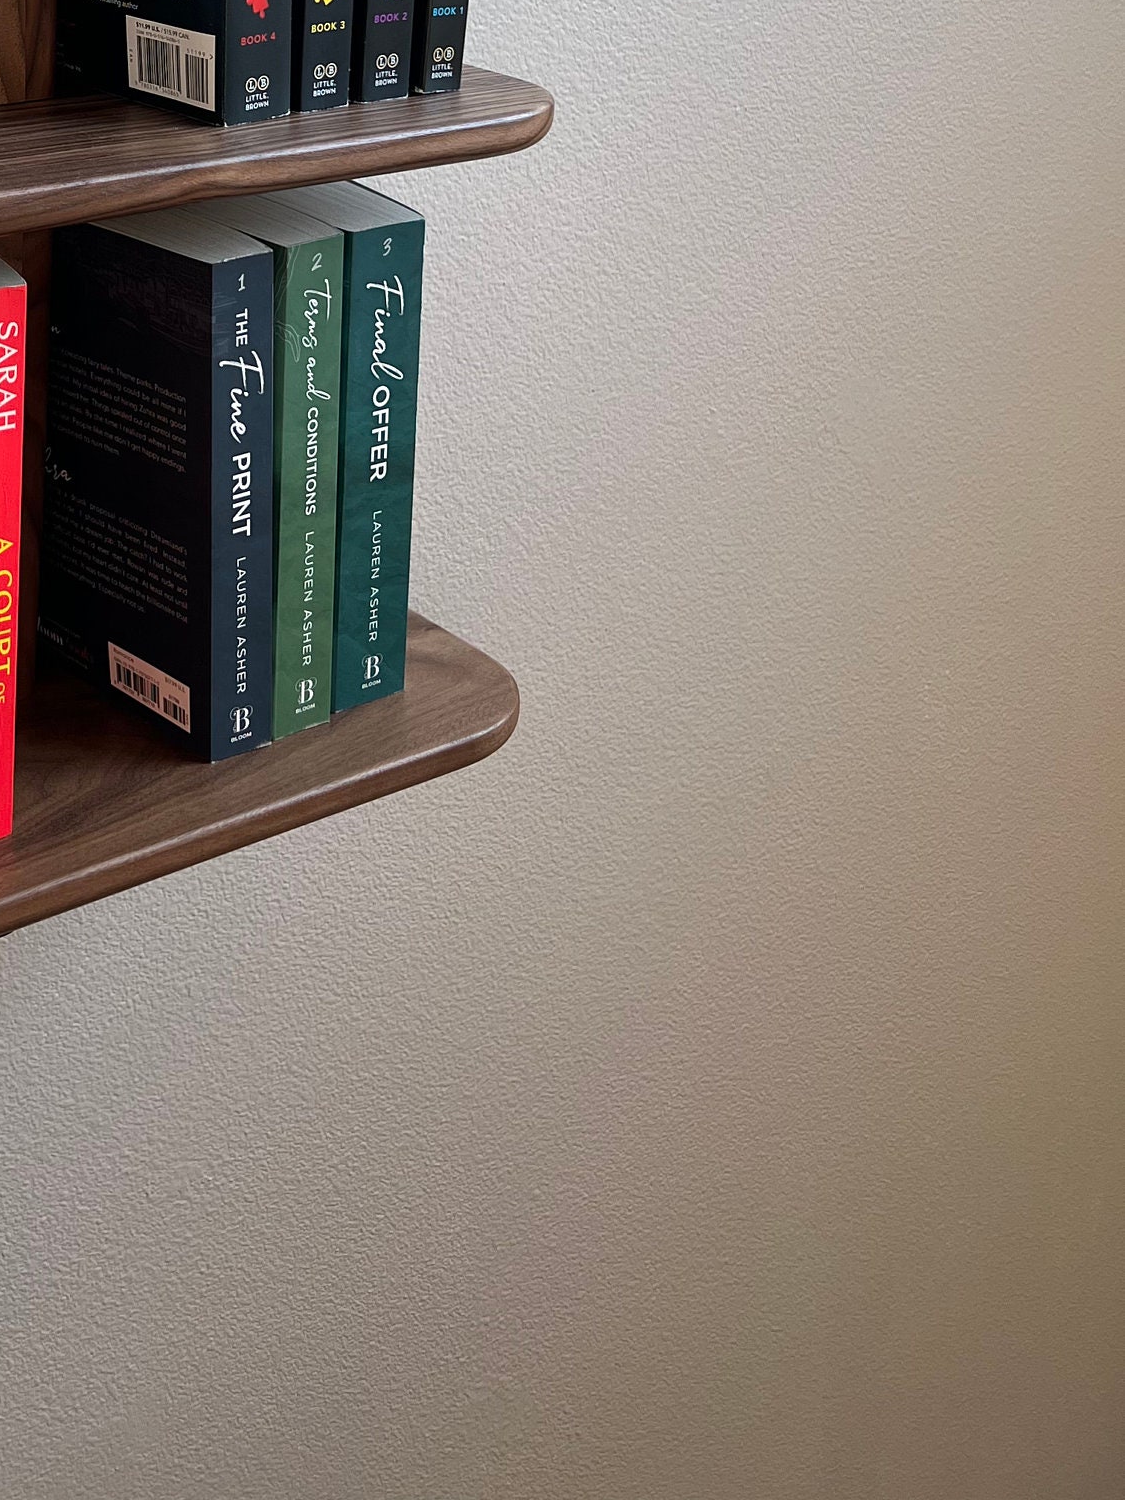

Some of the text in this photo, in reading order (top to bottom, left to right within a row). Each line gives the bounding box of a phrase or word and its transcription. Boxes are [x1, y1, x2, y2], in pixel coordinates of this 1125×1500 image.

[374, 12, 408, 24] BOOK 2
[432, 6, 464, 17] BOOK 1
[311, 21, 346, 34] BOOK 3
[240, 31, 276, 46] BOOK 4
[431, 71, 453, 79] BROWN
[375, 78, 398, 87] BROWN
[313, 88, 337, 97] BROWN
[245, 101, 269, 111] BROWN
[382, 238, 392, 257] 3
[311, 252, 323, 272] 2
[238, 273, 246, 292] 1
[366, 275, 404, 483] Final OFFER
[301, 278, 333, 516] Terms and CONDITIONS
[218, 307, 265, 537] THE Fine PRINT
[368, 510, 382, 643] LAUREN ASHER
[302, 531, 315, 666] LAUREN ASHER
[236, 556, 247, 694] LAUREN ASHER
[362, 679, 382, 690] BLOOM
[295, 703, 316, 714] BLOOM
[230, 731, 252, 743] BLOOM
